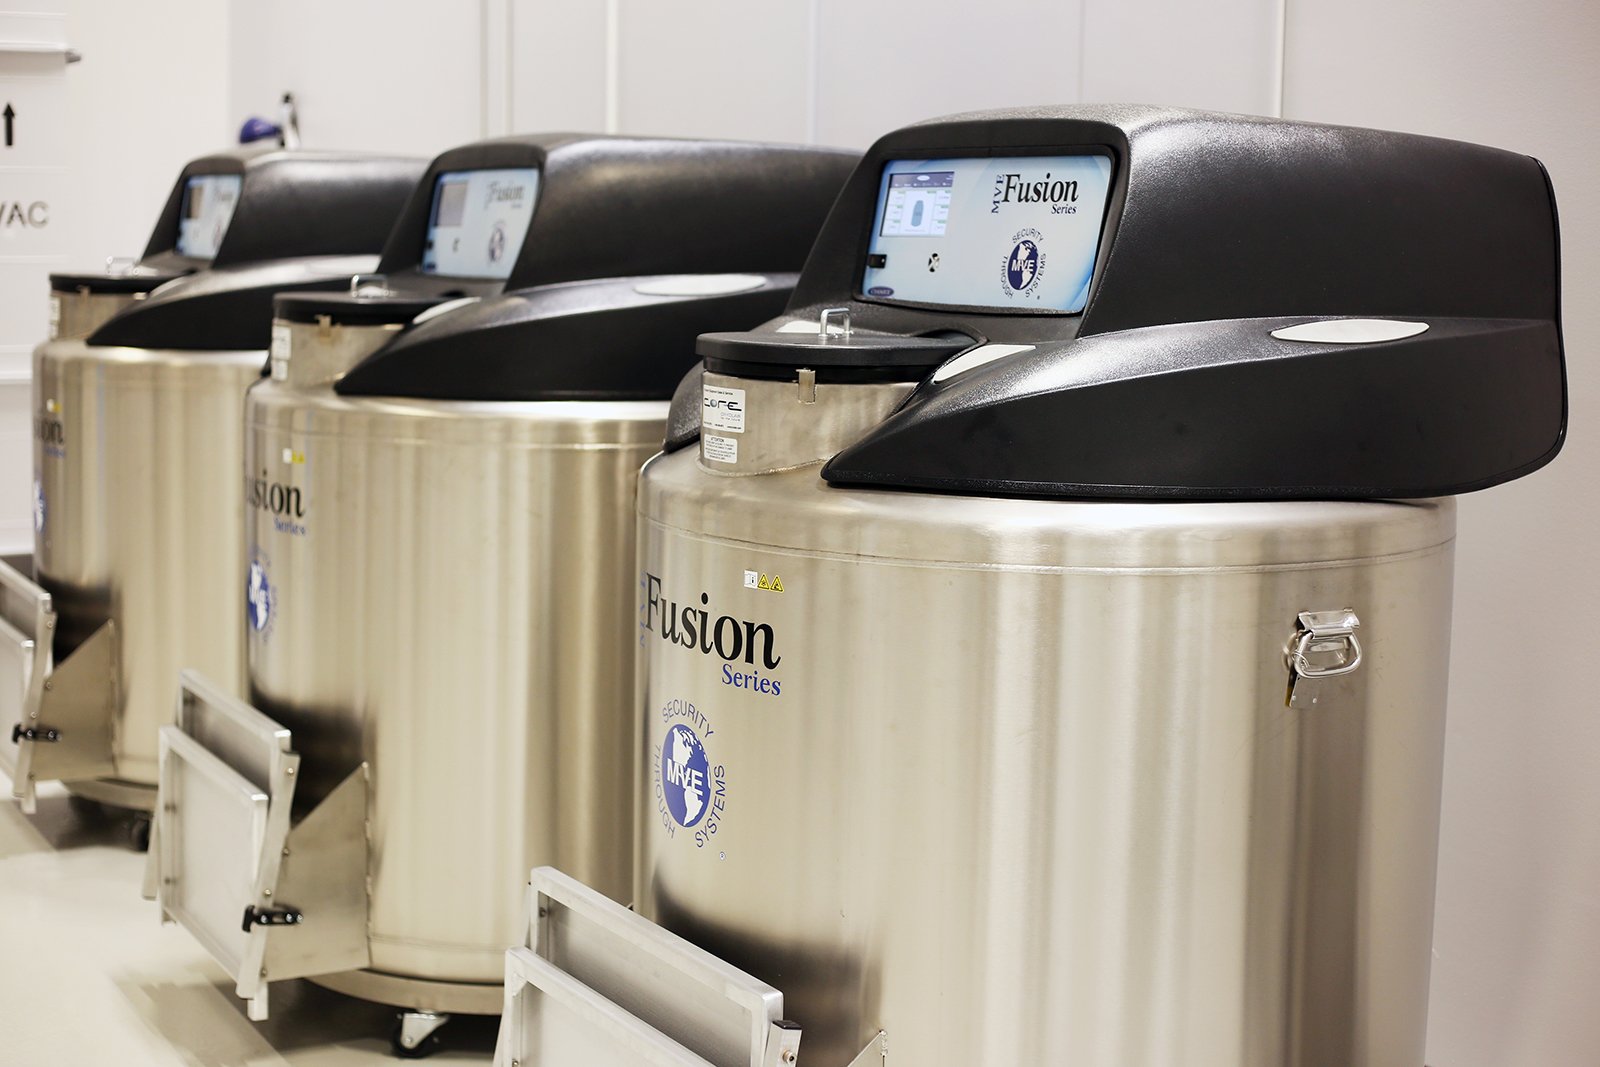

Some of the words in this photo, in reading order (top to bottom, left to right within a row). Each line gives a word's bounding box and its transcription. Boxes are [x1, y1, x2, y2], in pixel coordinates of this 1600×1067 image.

[1002, 172, 1079, 203] Fusion
[1051, 203, 1077, 215] Series
[1012, 227, 1044, 243] SECURITY
[1001, 255, 1014, 299] THROUGH
[1011, 259, 1035, 272] MVE
[1025, 253, 1047, 298] SYSTEMS
[645, 572, 782, 670] Fusion
[722, 663, 781, 696] Series
[662, 699, 714, 738] SECURITY
[654, 744, 675, 839] THROUGH
[667, 757, 703, 796] MVE
[695, 765, 726, 848] SYSTEMS
